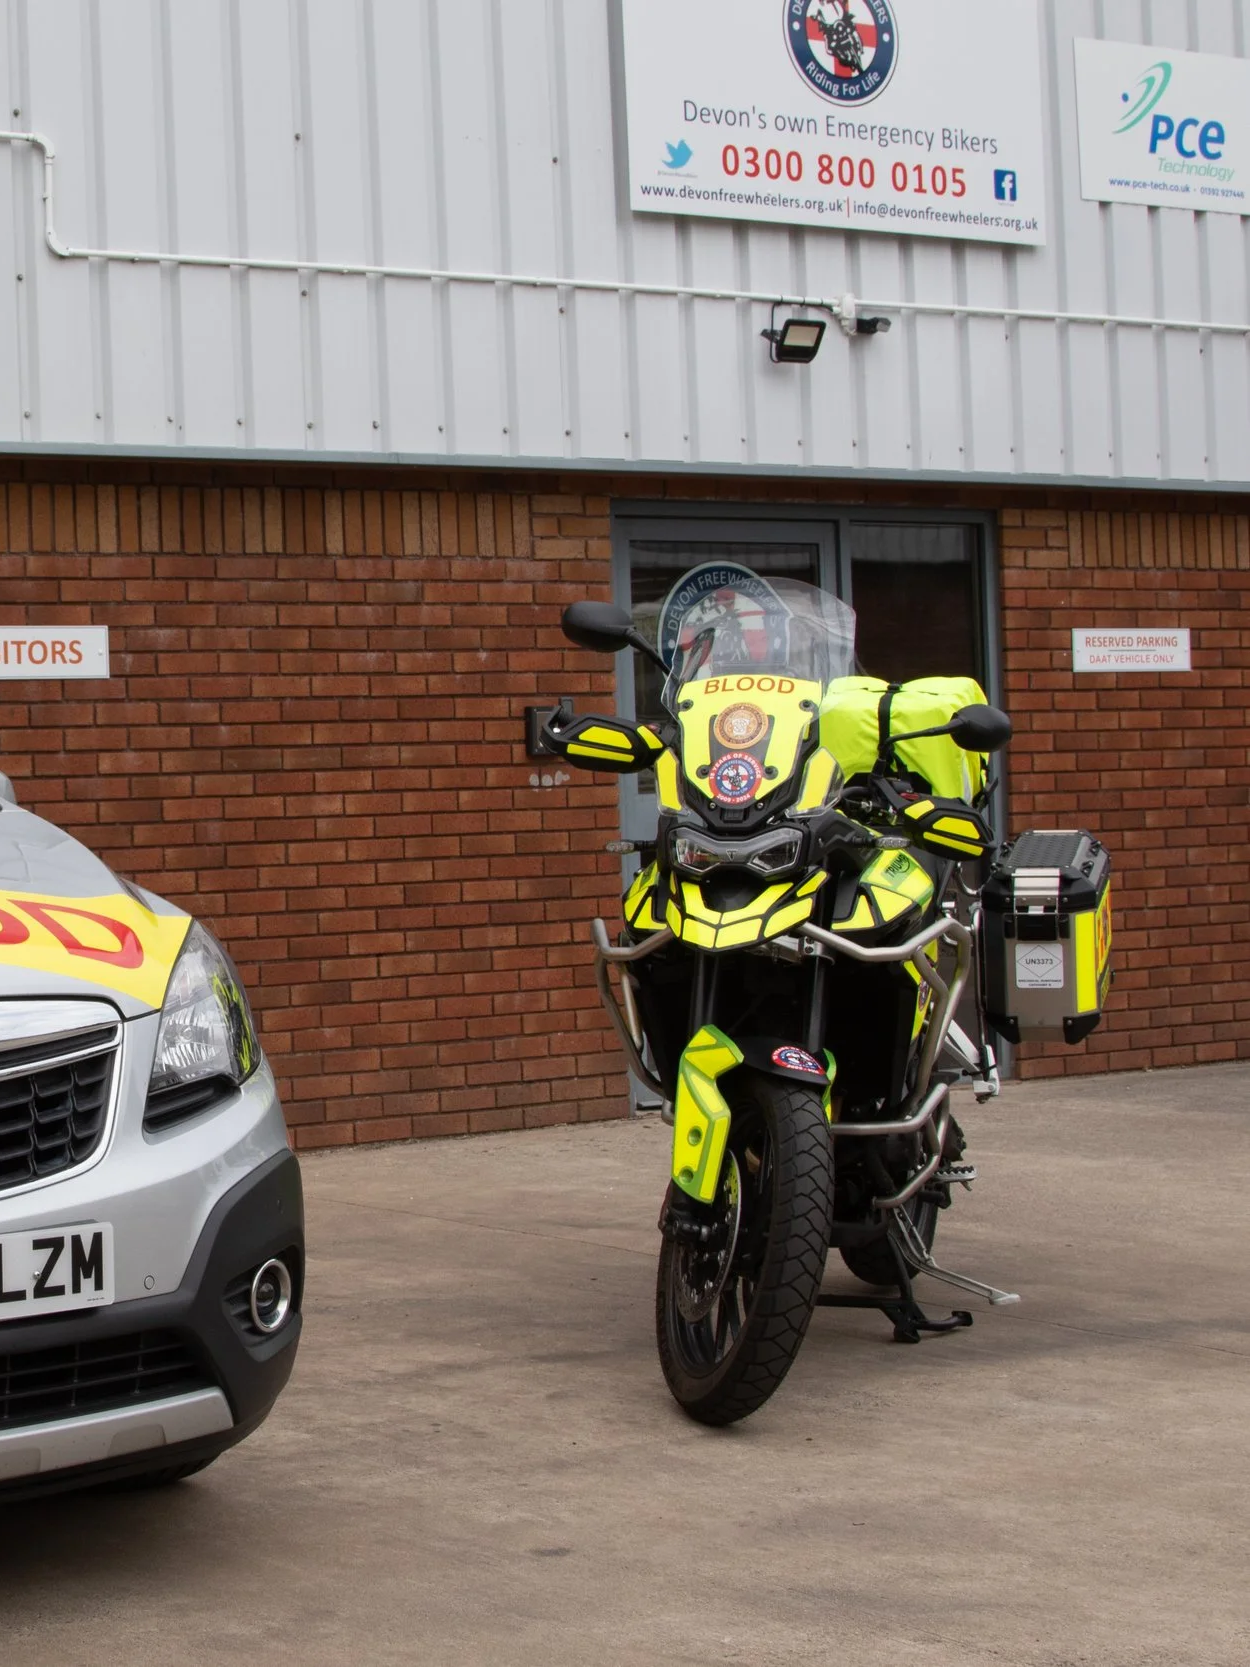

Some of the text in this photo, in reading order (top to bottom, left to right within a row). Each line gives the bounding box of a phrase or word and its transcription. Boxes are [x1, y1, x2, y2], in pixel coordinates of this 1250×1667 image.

[805, 61, 881, 97] Riding For Life
[683, 100, 998, 154] Devon's own Emergency Bikers
[721, 144, 967, 198] 0300 800 0105
[1157, 157, 1235, 182] Technology
[640, 184, 843, 213] www.devonfreewheelers.org.uk
[1108, 178, 1191, 194] www.pce-tech.co.uk
[853, 200, 1039, 231] info@devonfreewheelers.org.uk
[667, 581, 699, 632] DEVON
[1085, 635, 1178, 648] RESERVED PARKING
[1089, 654, 1175, 664] DAAT VEHICLE ONLY
[704, 676, 795, 695] BLOOD
